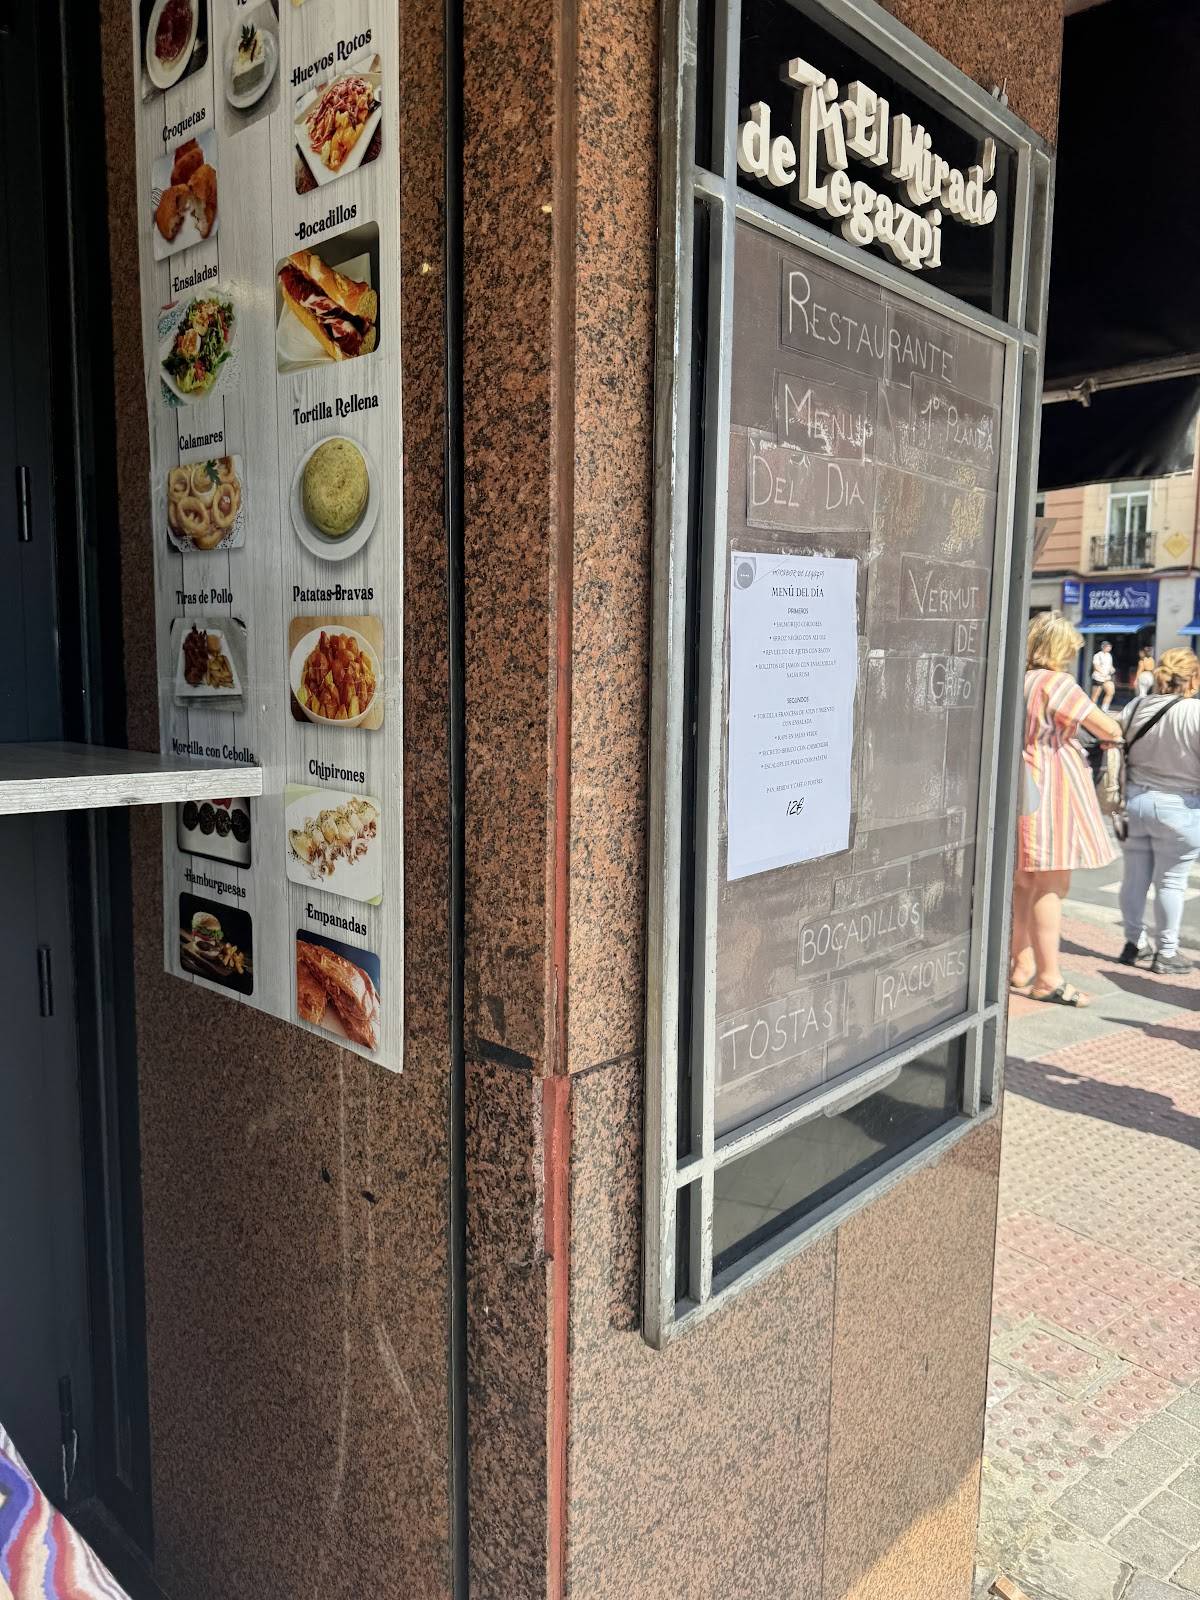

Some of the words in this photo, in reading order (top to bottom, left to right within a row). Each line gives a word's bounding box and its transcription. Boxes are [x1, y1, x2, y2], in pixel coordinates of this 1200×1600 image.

[291, 52, 334, 86] Huevos
[337, 29, 372, 61] Rotos
[162, 107, 206, 142] Croquetas
[737, 101, 797, 187] de
[800, 87, 942, 271] Legazpi
[295, 203, 357, 240] Bocadillos
[172, 264, 218, 292] Ensaladas
[789, 271, 953, 383] RESTAURANTE
[293, 400, 332, 425] Tortilla
[335, 394, 379, 418] Rellena
[179, 430, 223, 450] Calamares
[752, 455, 800, 508] DEL
[176, 591, 197, 604] Tiras
[198, 589, 209, 603] de
[210, 588, 233, 604] Pollo
[293, 586, 332, 602] Patatas
[331, 584, 374, 601] Bravas
[771, 584, 794, 597] MENÚ
[796, 587, 809, 597] DEL
[810, 585, 824, 598] DÍA
[908, 569, 979, 614] VERMUT
[1089, 598, 1129, 610] ROMA
[957, 622, 977, 653] DE
[172, 738, 204, 756] Morcilla
[205, 746, 221, 758] con
[222, 744, 255, 763] Cebolla
[308, 759, 365, 783] Chipirones
[184, 869, 246, 898] Hamburguesas
[305, 902, 367, 936] Empanadas
[801, 902, 920, 967] BOCADILLOS
[881, 950, 966, 1015] RACIONES
[720, 1000, 833, 1070] TOSTAS
